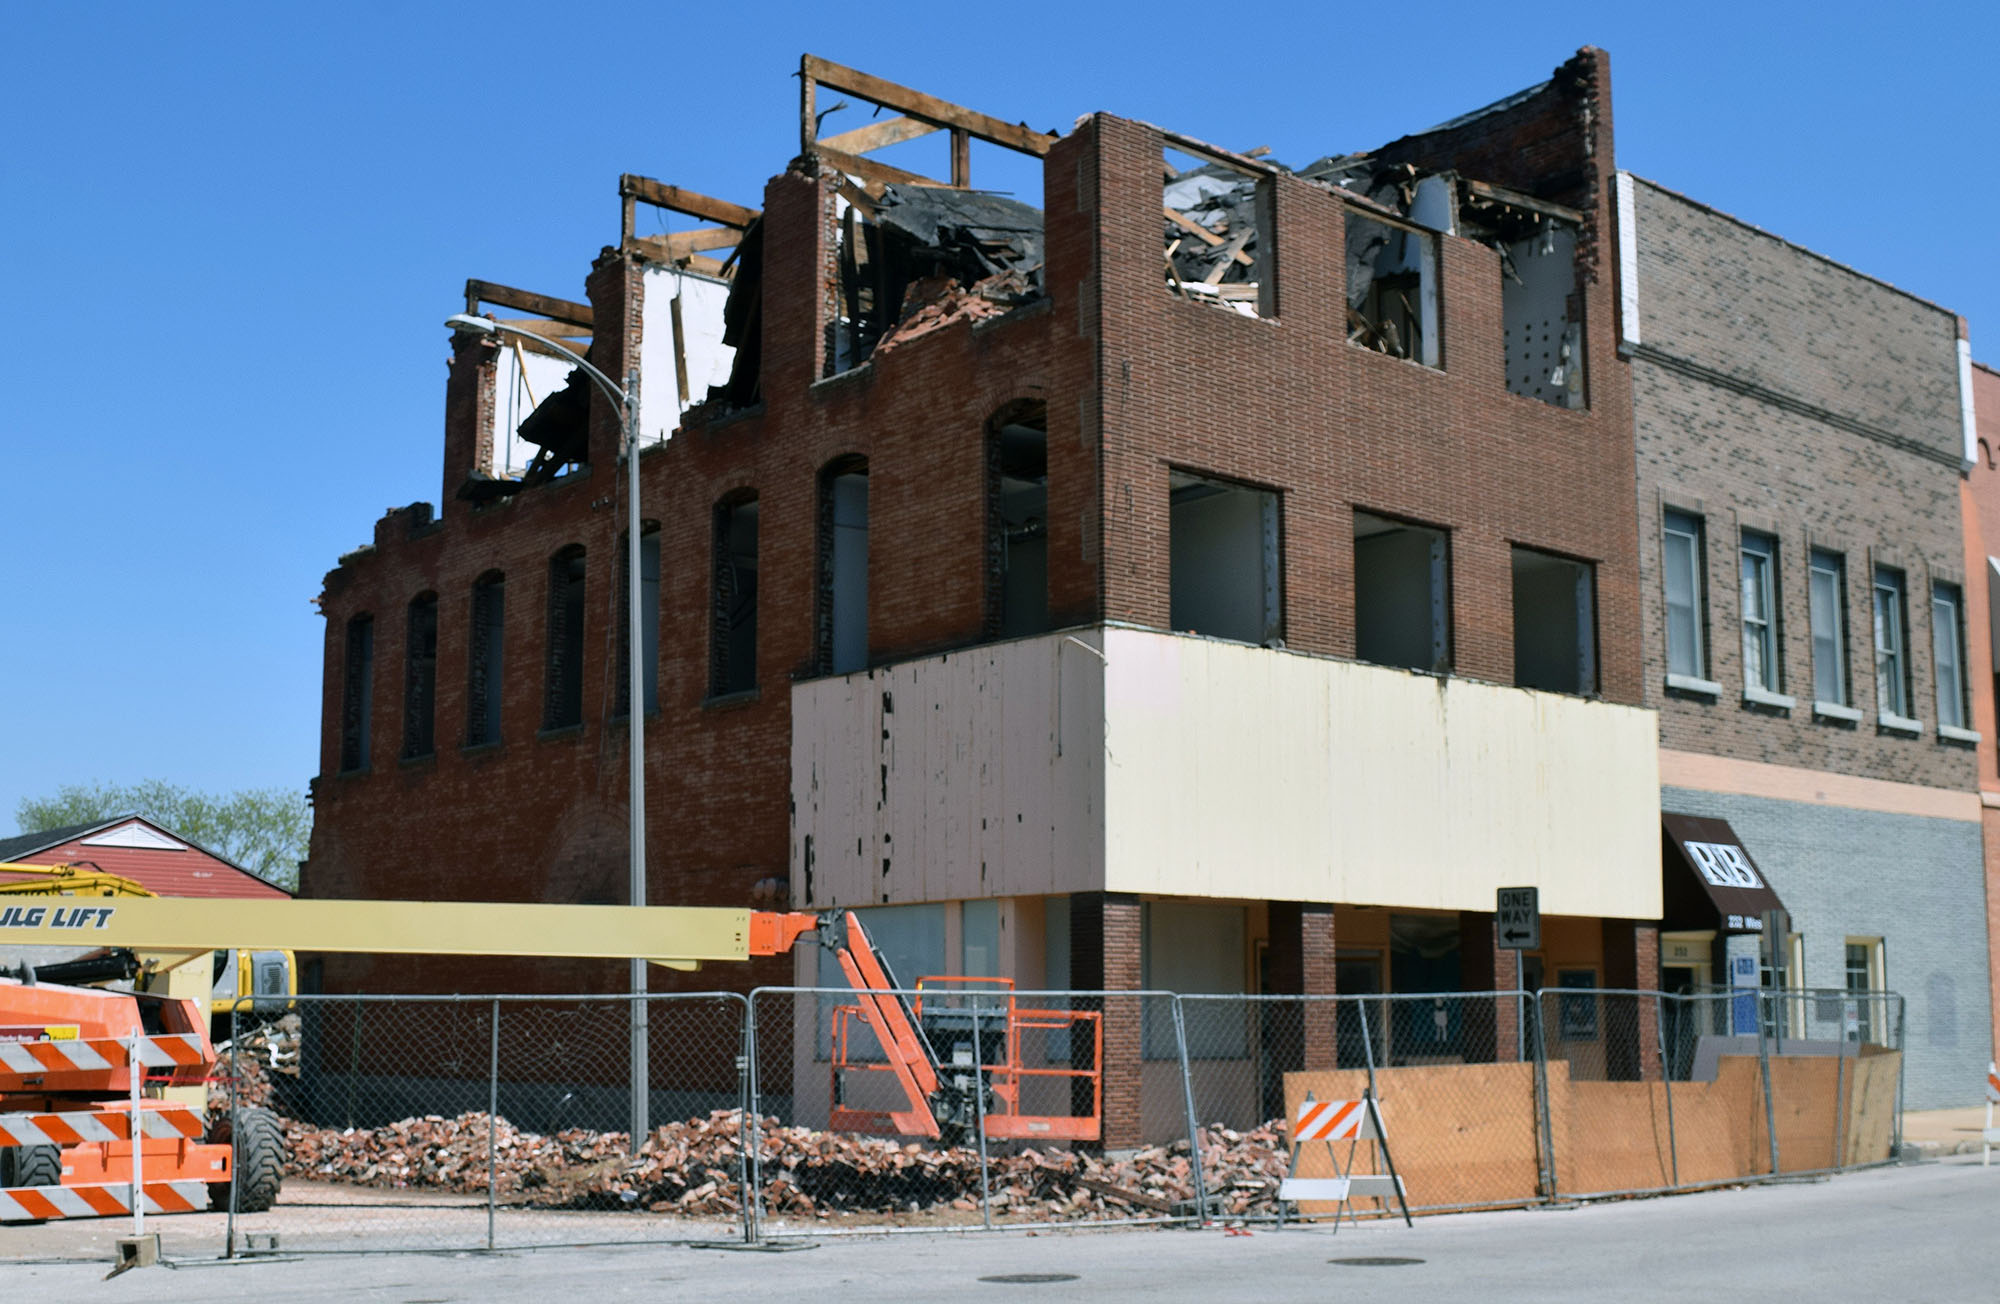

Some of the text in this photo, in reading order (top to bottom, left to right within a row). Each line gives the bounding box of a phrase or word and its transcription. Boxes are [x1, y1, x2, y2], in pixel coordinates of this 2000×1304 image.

[1502, 893, 1531, 907] ONE
[0, 907, 114, 928] JLG LIFT
[1501, 910, 1531, 924] WAY
